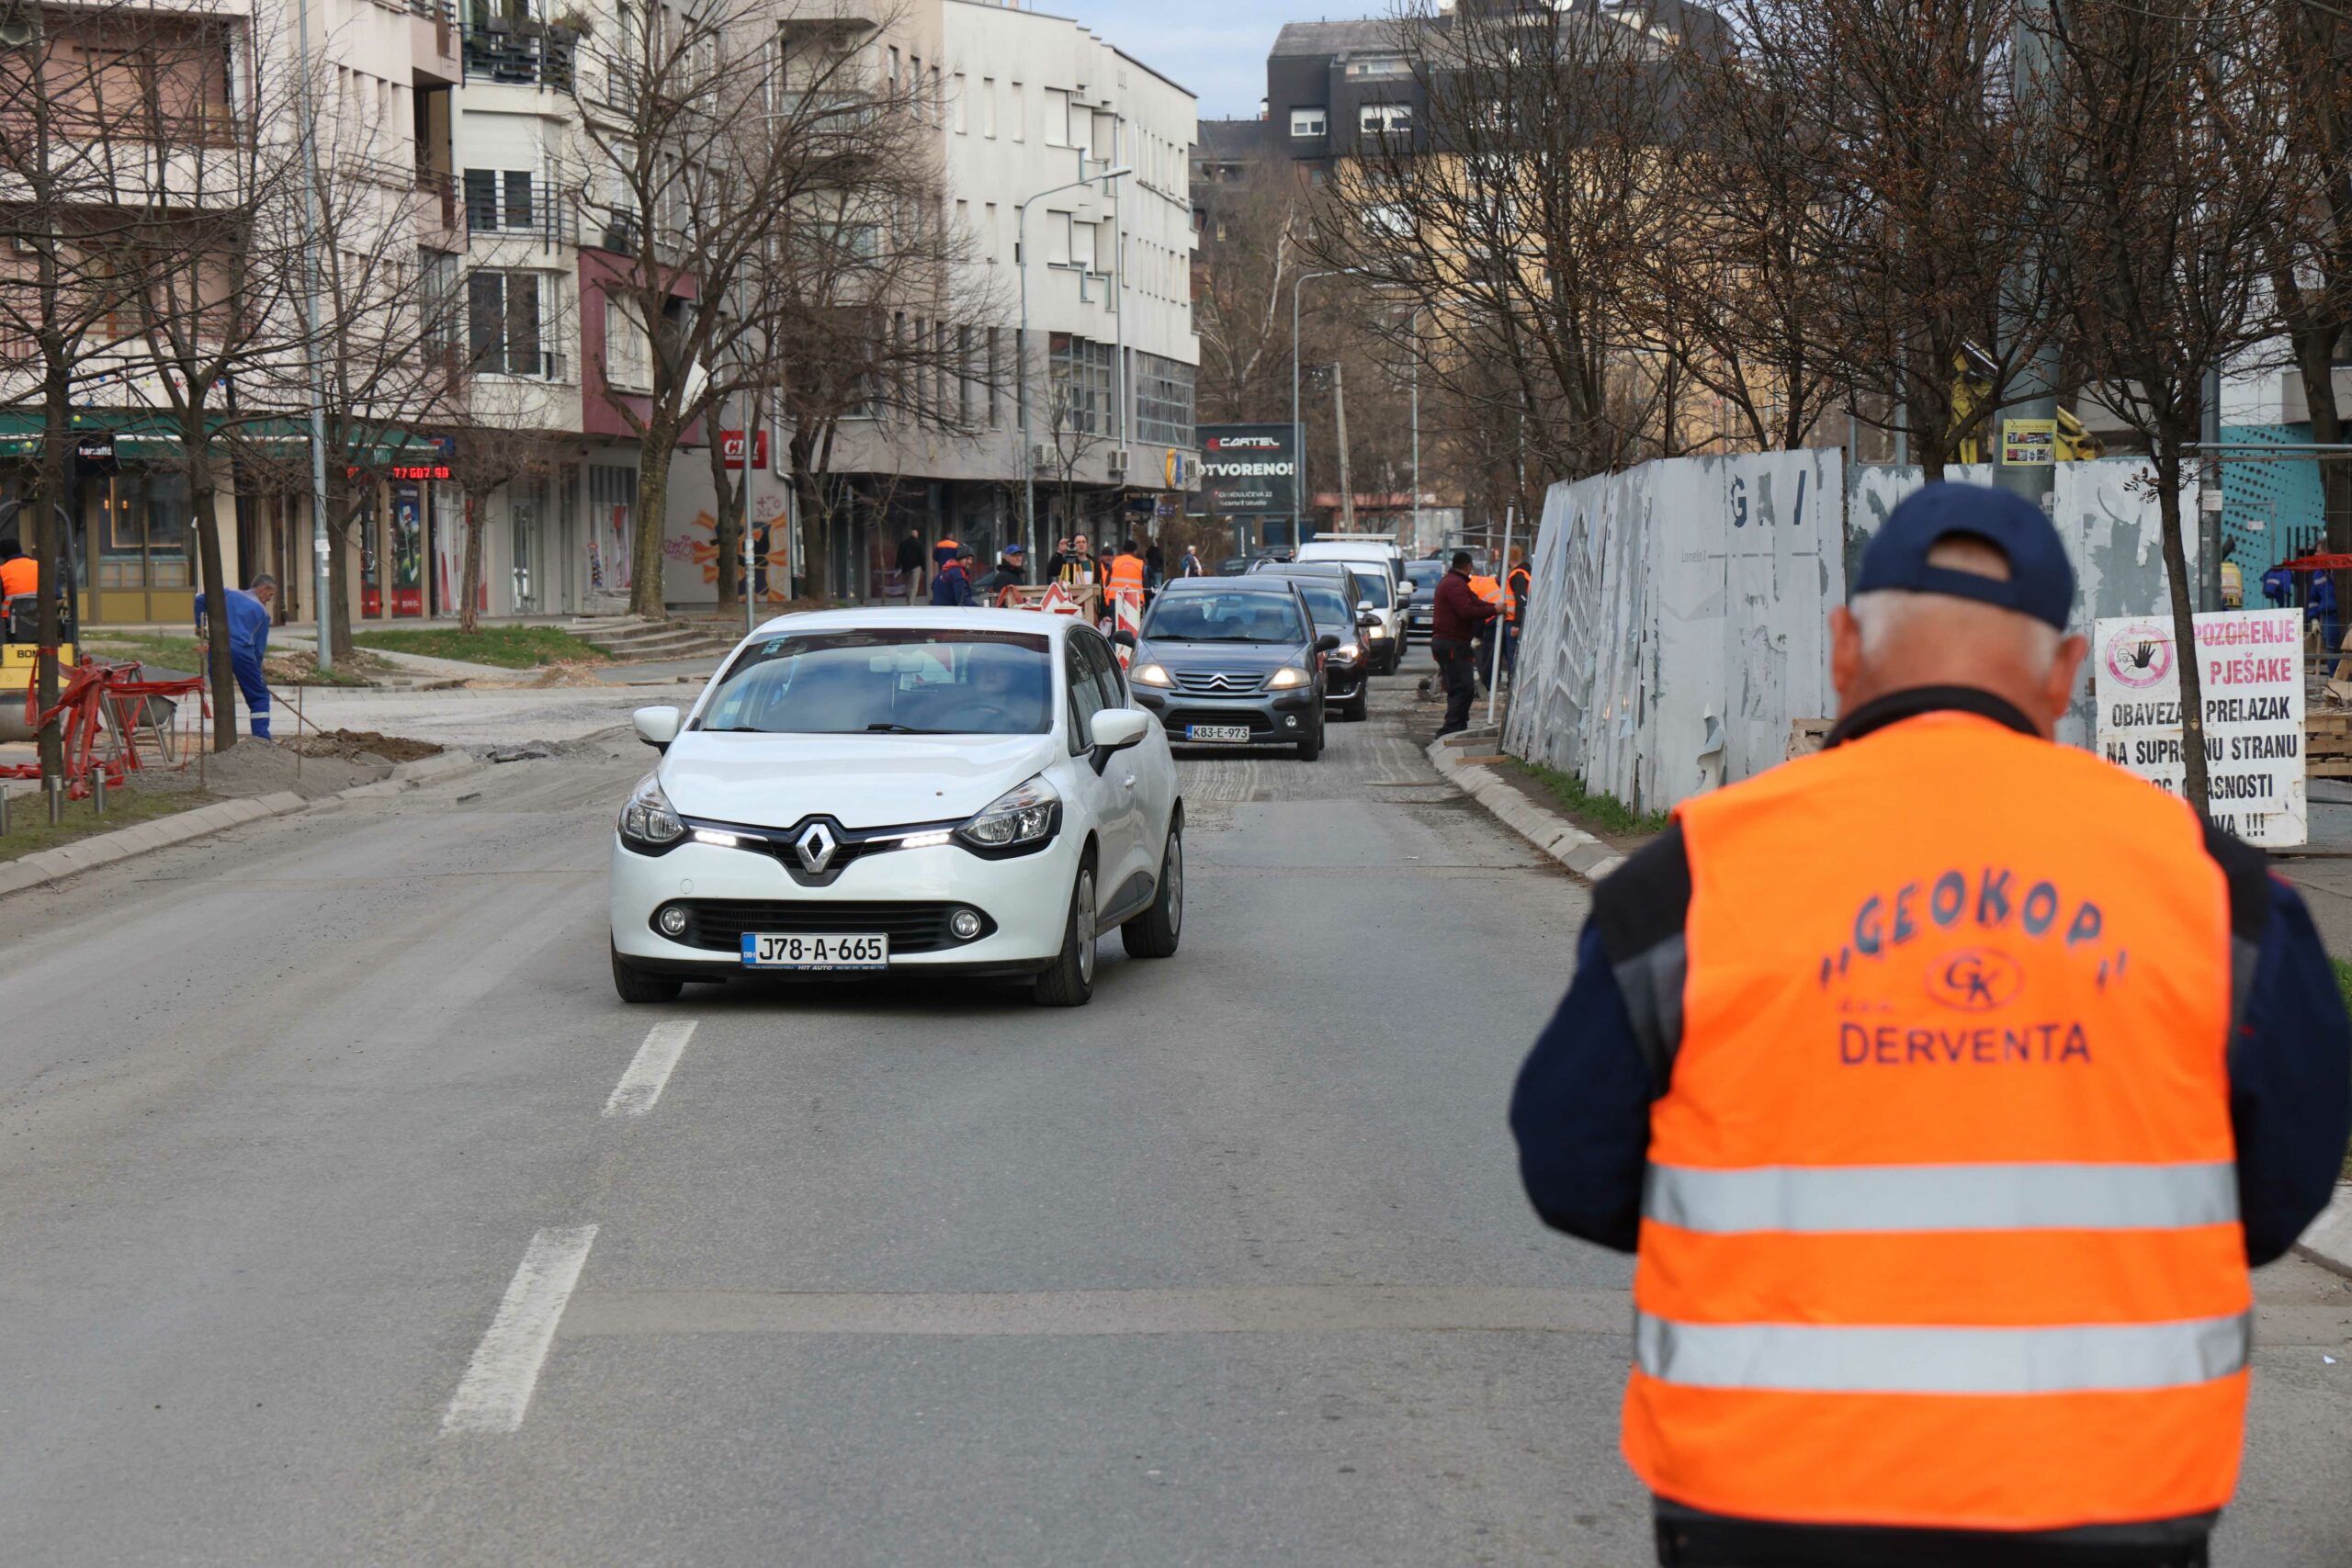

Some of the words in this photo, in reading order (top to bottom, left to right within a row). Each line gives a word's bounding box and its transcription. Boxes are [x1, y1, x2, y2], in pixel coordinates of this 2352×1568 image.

[1219, 437, 1280, 446] CARTEL
[2193, 619, 2295, 647] POZORENJE
[2210, 652, 2292, 685] PJEŠAKE
[2112, 702, 2184, 728] OBAVEZA
[2206, 696, 2290, 723] PRELAZAK
[1193, 727, 1248, 739] K83-E-973
[2106, 741, 2129, 765] NA
[2136, 737, 2223, 764] SUPRNU
[2232, 734, 2298, 761] STRANU
[2182, 773, 2272, 799] ASNOSTI
[759, 938, 882, 960] J78-A-665
[1840, 1022, 2092, 1065] DERVENTA
